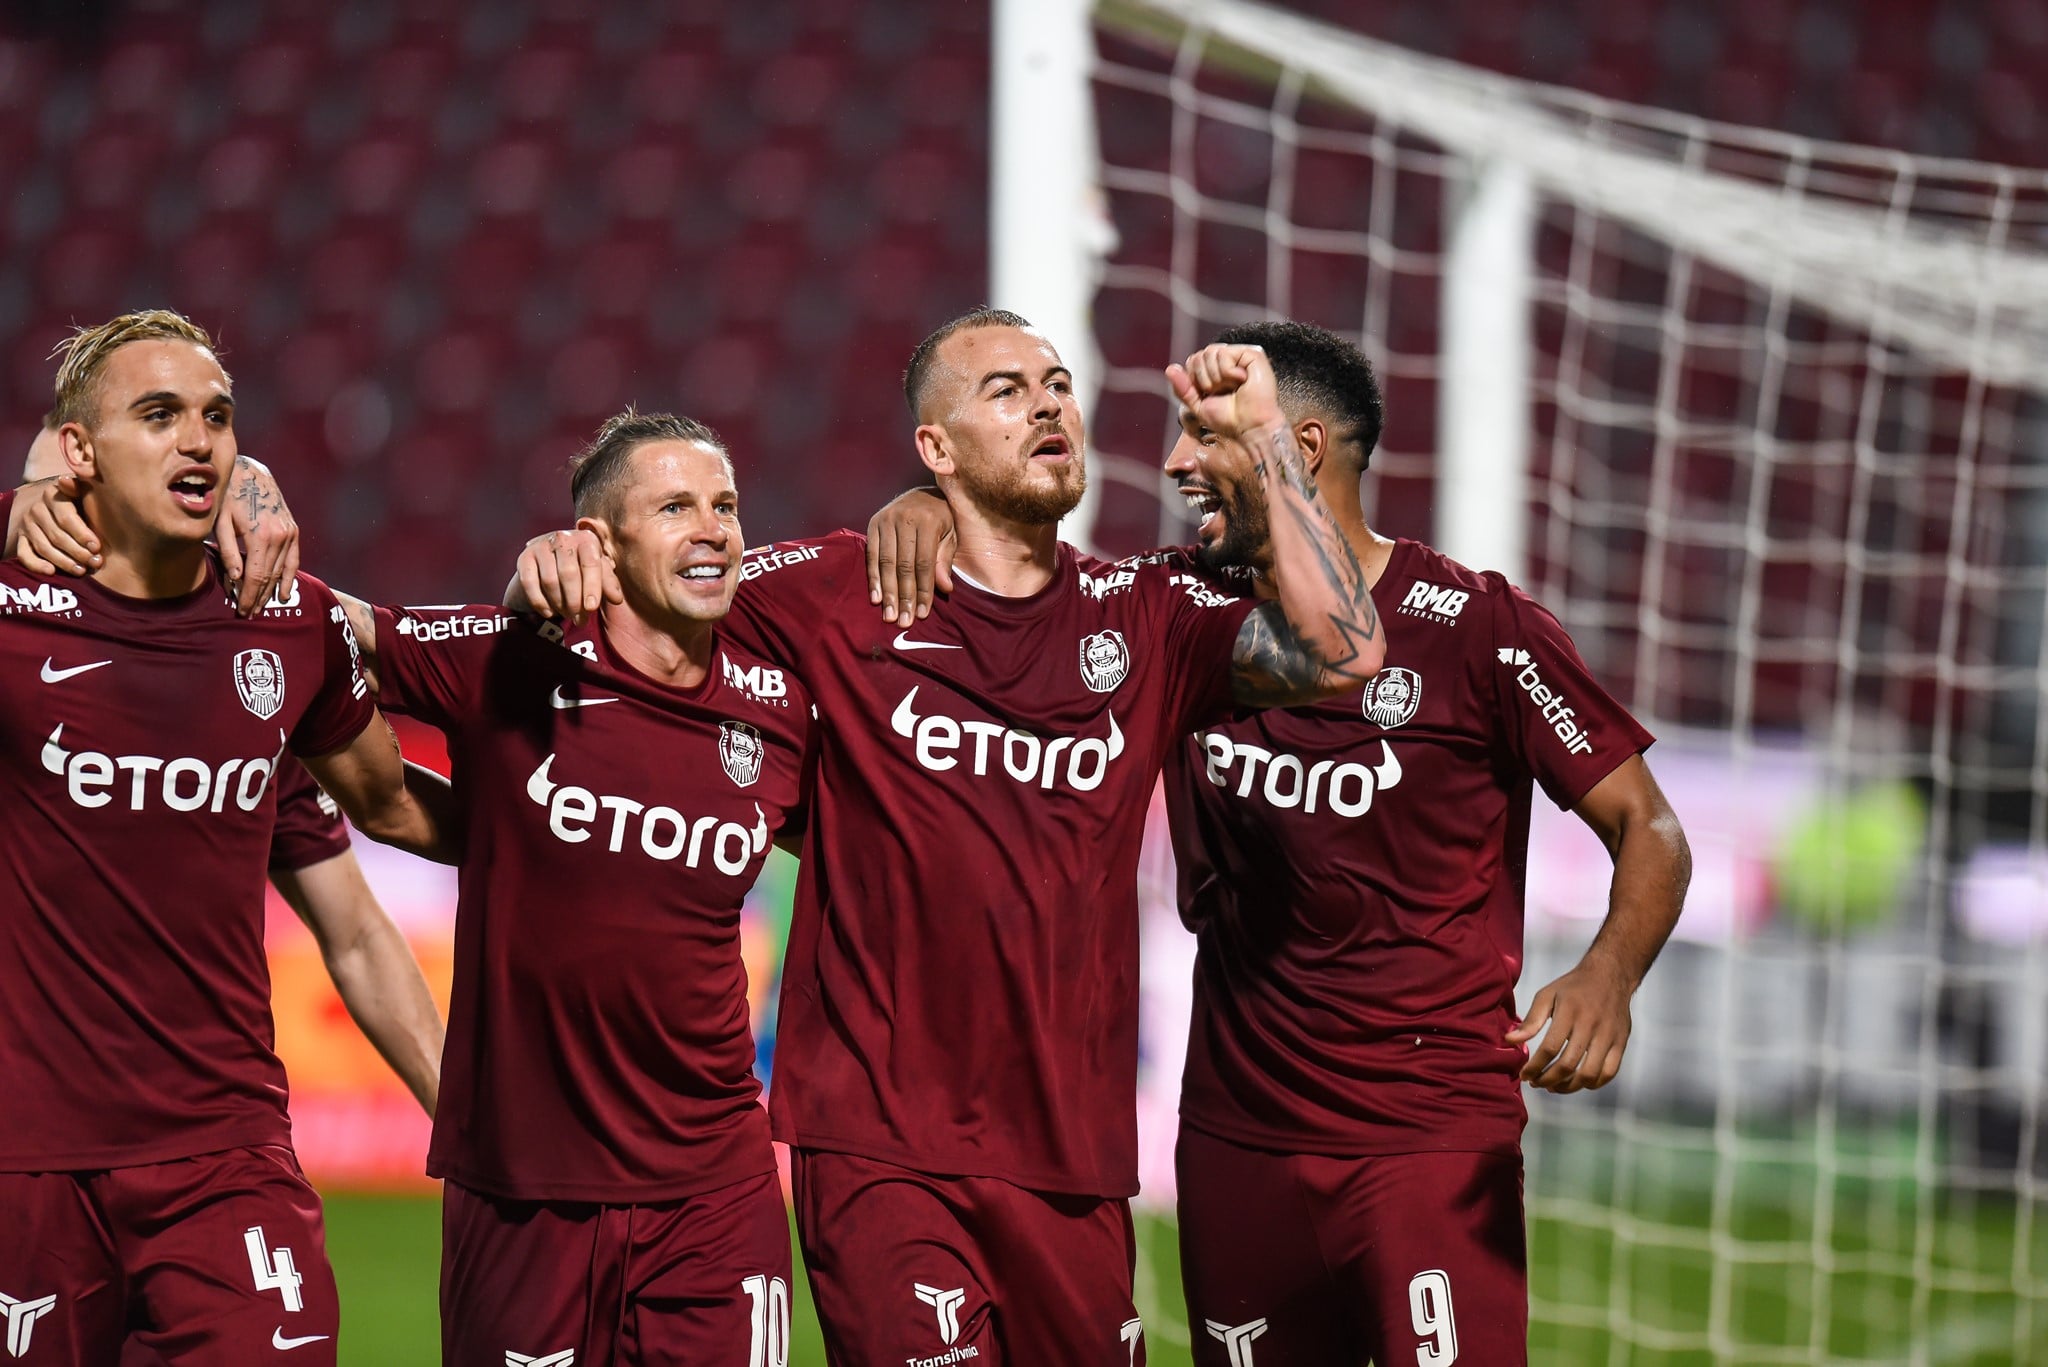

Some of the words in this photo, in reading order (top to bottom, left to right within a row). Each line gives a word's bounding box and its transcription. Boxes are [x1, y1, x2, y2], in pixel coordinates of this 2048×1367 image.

[411, 614, 517, 642] betfair
[1396, 606, 1456, 627] INTERAUTO
[1402, 581, 1470, 617] RMB
[1516, 662, 1593, 756] betfair
[243, 1225, 304, 1313] 4
[741, 1273, 791, 1367] 10
[1408, 1269, 1459, 1367] 9
